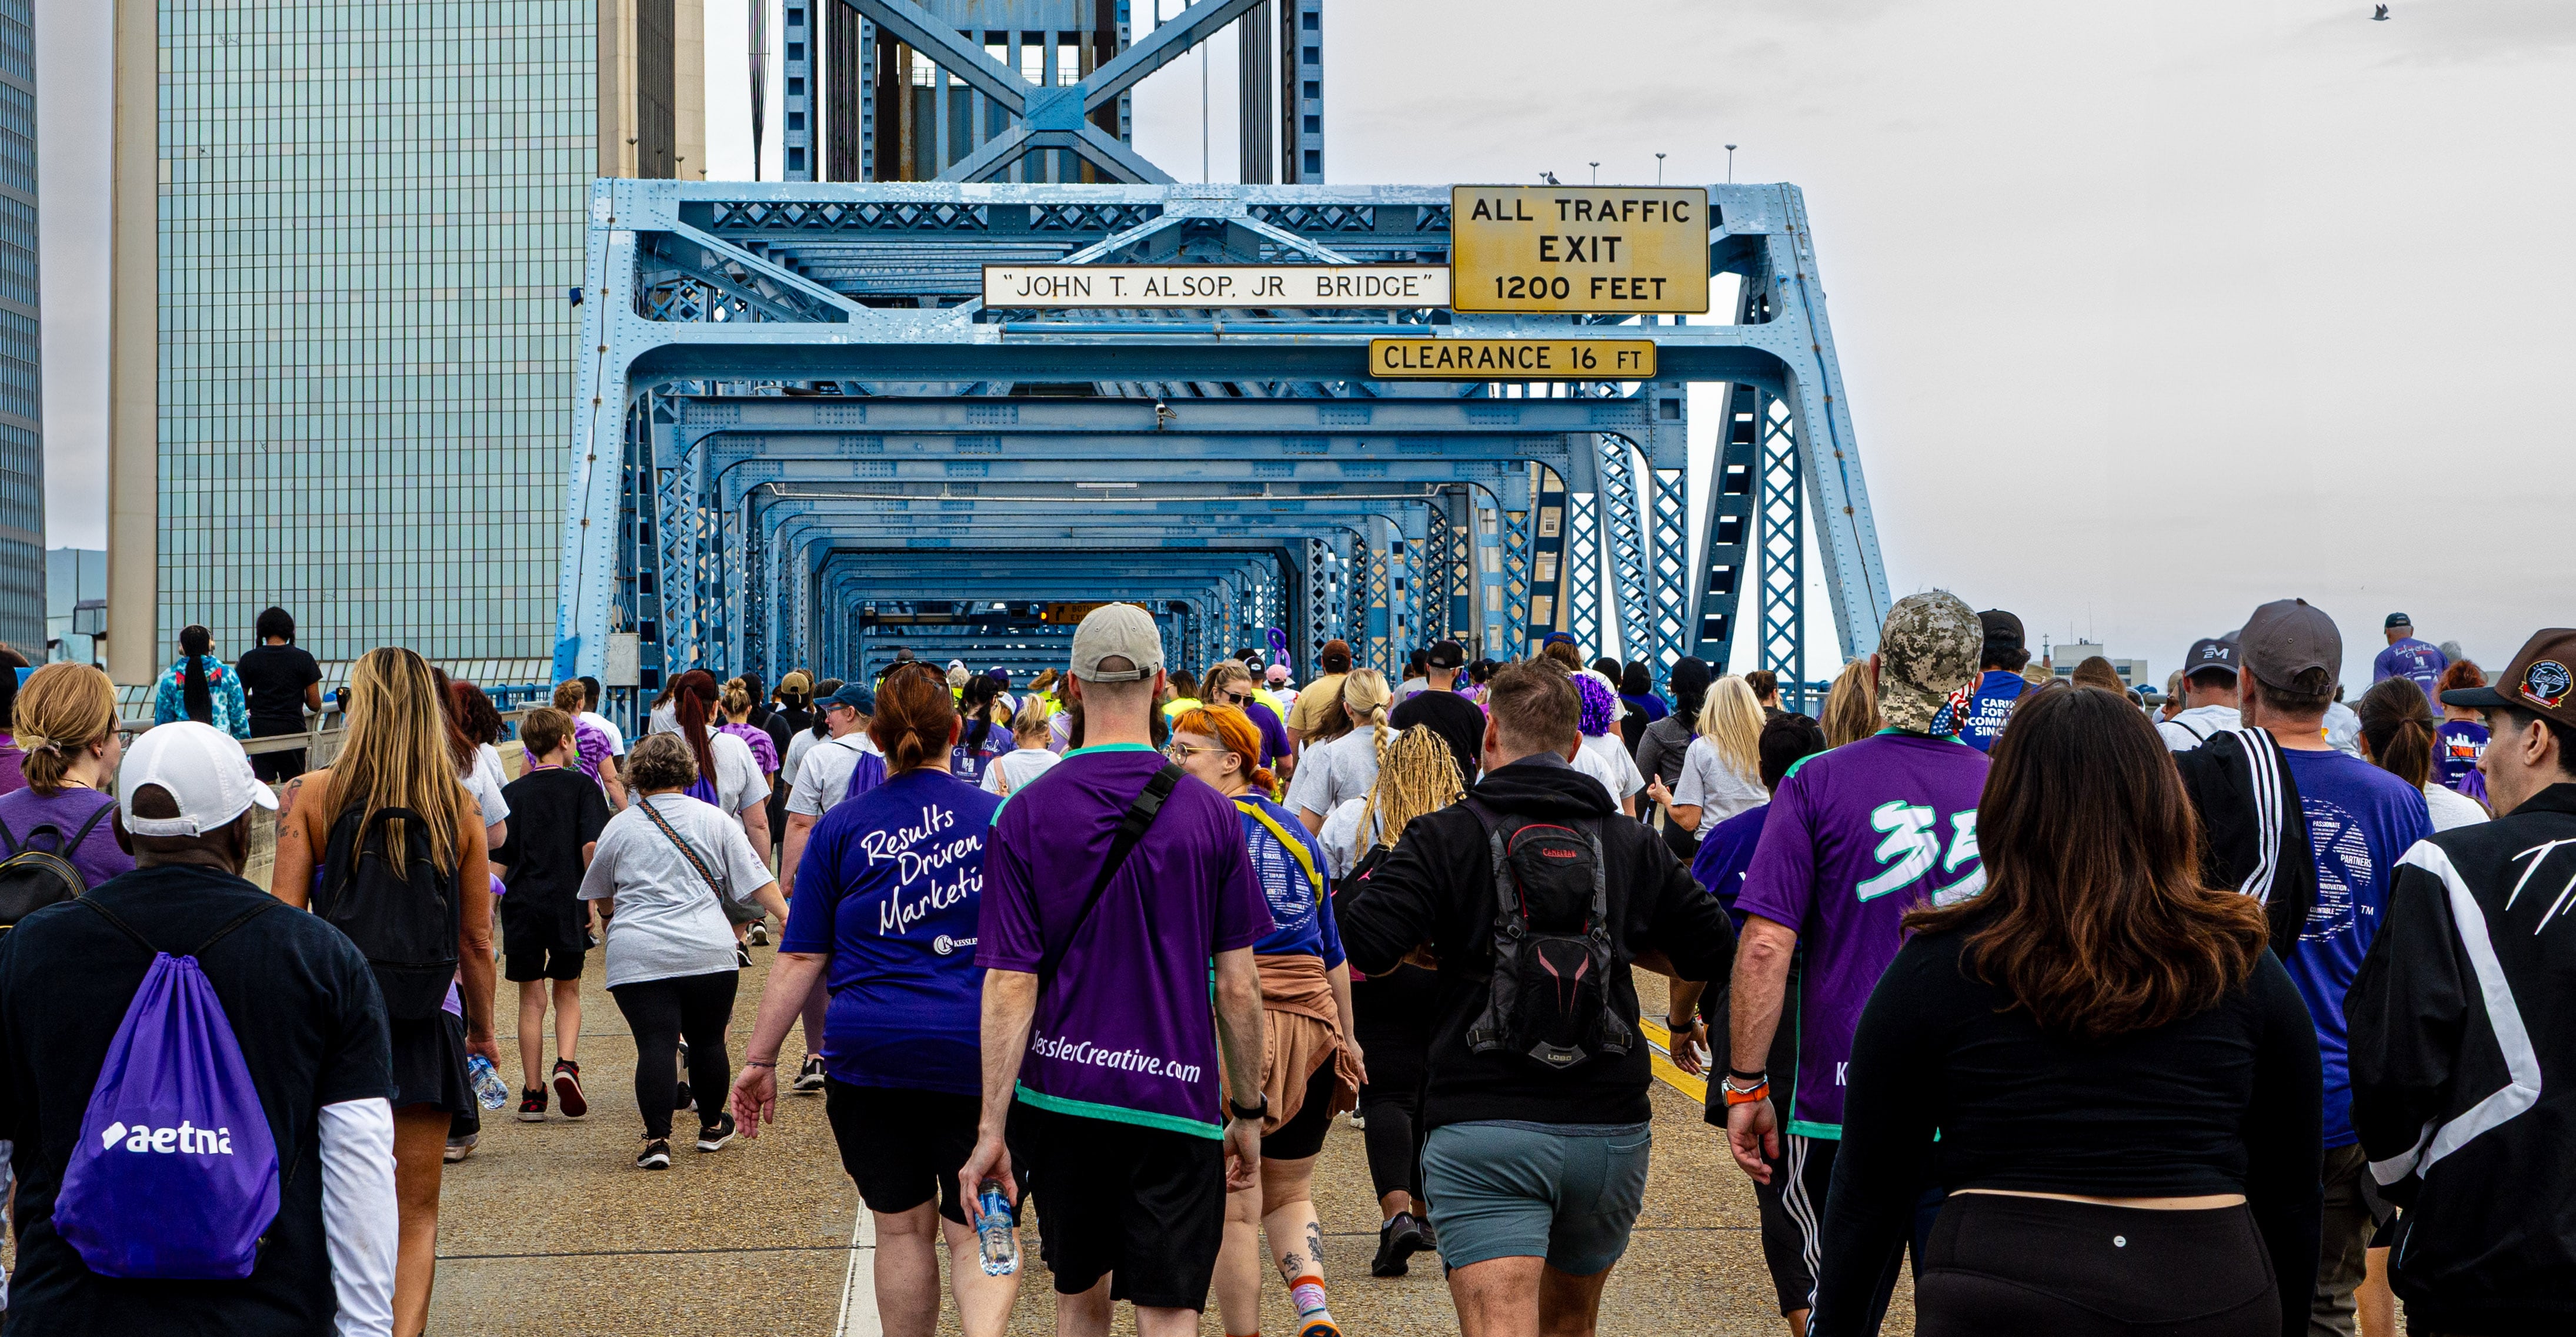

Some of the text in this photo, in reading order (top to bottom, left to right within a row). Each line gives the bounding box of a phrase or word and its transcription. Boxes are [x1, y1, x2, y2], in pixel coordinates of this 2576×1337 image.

[1471, 199, 1690, 223] ALL TRAFFIC
[1540, 236, 1621, 262] EXIT
[1110, 276, 1127, 296] T.
[1144, 276, 1236, 298] ALSOP,
[1252, 276, 1286, 296] JR
[1496, 276, 1666, 300] 1200 FEET
[1384, 346, 1641, 369] CLEARANCE 16 FT
[1981, 698, 2016, 708] CARIN
[1981, 707, 2005, 717] FOR
[1968, 717, 2009, 726] COMM
[1975, 727, 2004, 737] SINC
[2452, 746, 2474, 757] SAVE
[2313, 820, 2341, 829] PASSIONATE
[861, 804, 954, 866] Results
[1543, 847, 1577, 858] CAMELBAK
[1856, 800, 1988, 907] 35
[897, 835, 983, 886] Driven
[2340, 854, 2372, 868] PARTNERS
[2319, 883, 2347, 891] INNOVATION
[2310, 906, 2335, 915] COUNTABLE
[2361, 905, 2374, 915] TM
[953, 938, 978, 947] KESSLE
[126, 1120, 233, 1156] aetna
